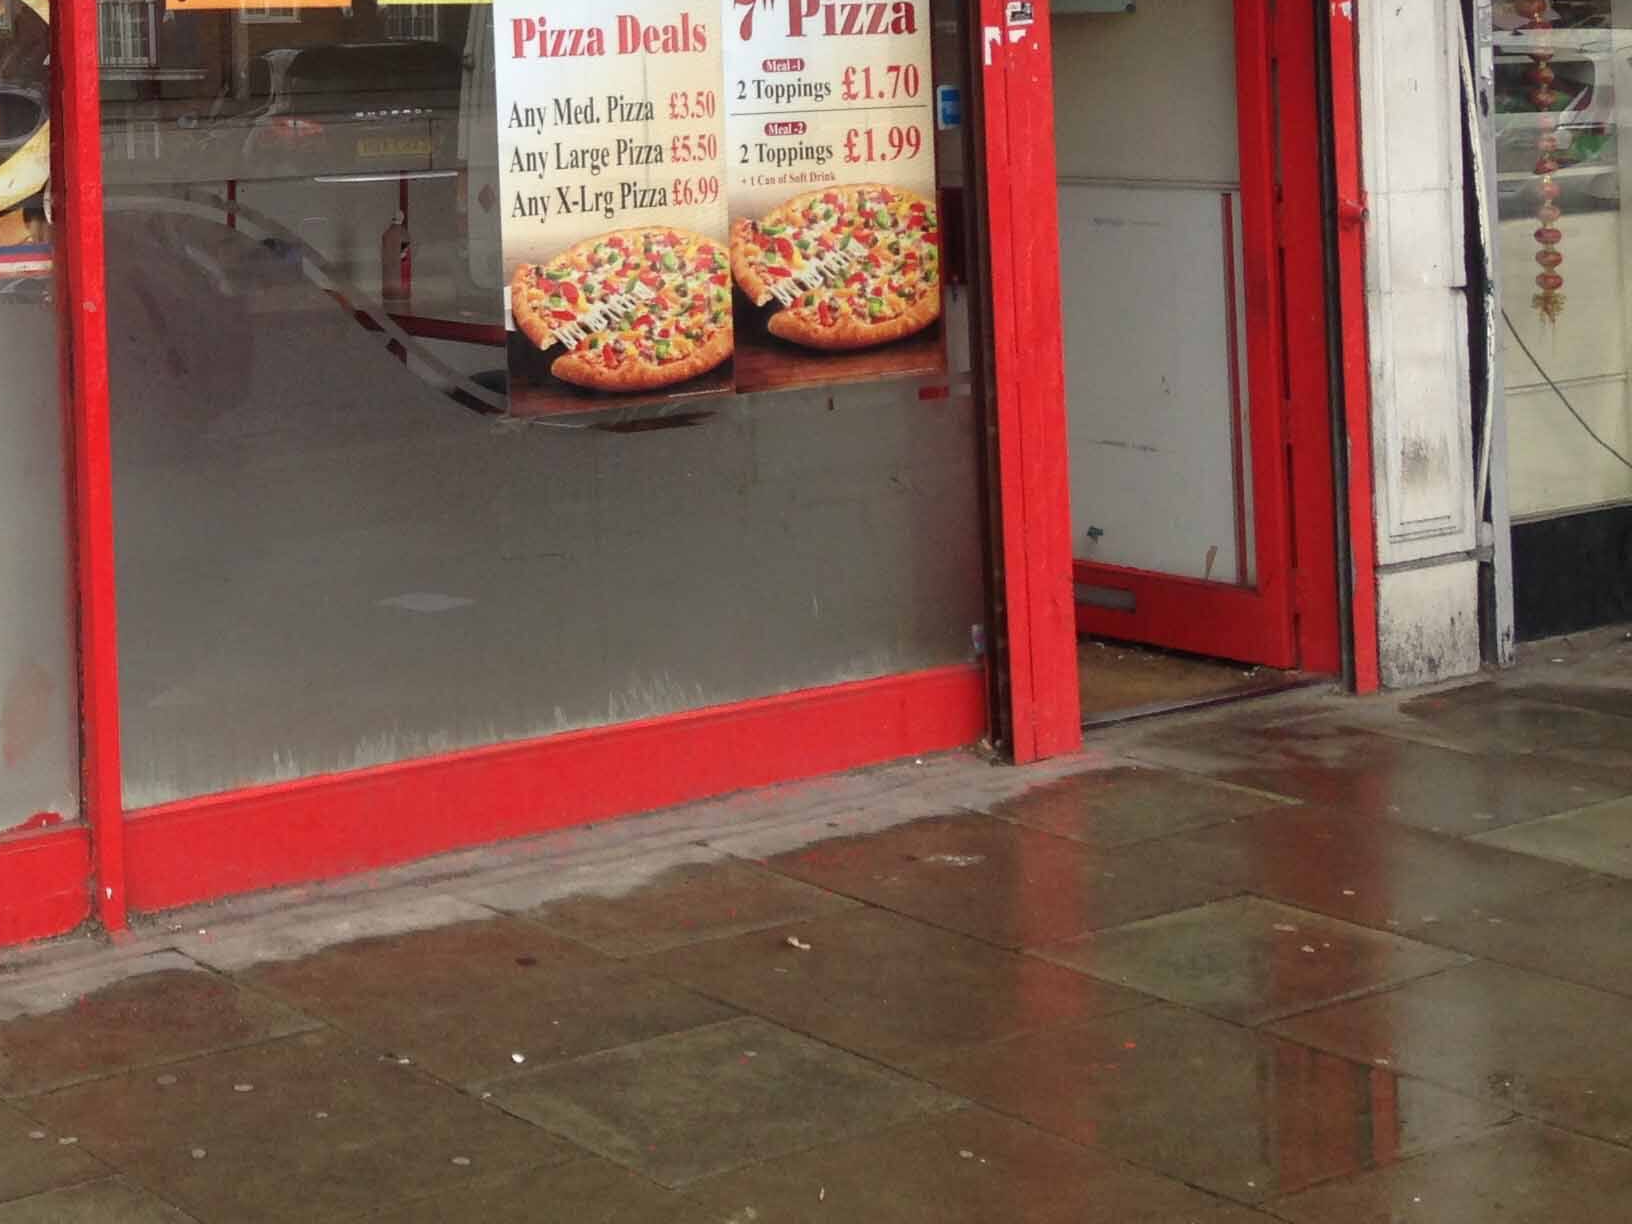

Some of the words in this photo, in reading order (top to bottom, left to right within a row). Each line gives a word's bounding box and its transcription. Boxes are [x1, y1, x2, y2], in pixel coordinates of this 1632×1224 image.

[511, 17, 606, 59] Pizza
[616, 12, 708, 55] Deals
[737, 79, 748, 100] 2
[751, 77, 832, 104] Toppings
[841, 63, 920, 101] £1.70
[508, 100, 547, 134] Any
[553, 97, 601, 127] Med.
[607, 95, 654, 123] Pizza
[668, 90, 716, 120] £3.50
[510, 144, 549, 178] Any
[555, 141, 610, 173] Large
[616, 138, 663, 166] Pizza
[670, 134, 718, 163] £5.50
[739, 143, 750, 164] 2
[755, 140, 833, 167] Toppings
[843, 126, 922, 163] £1.99
[809, 170, 836, 183] Drink
[511, 187, 551, 222] Any
[556, 184, 615, 219] X-Lrg
[619, 181, 668, 209] Pizza
[672, 177, 719, 206] £6.99
